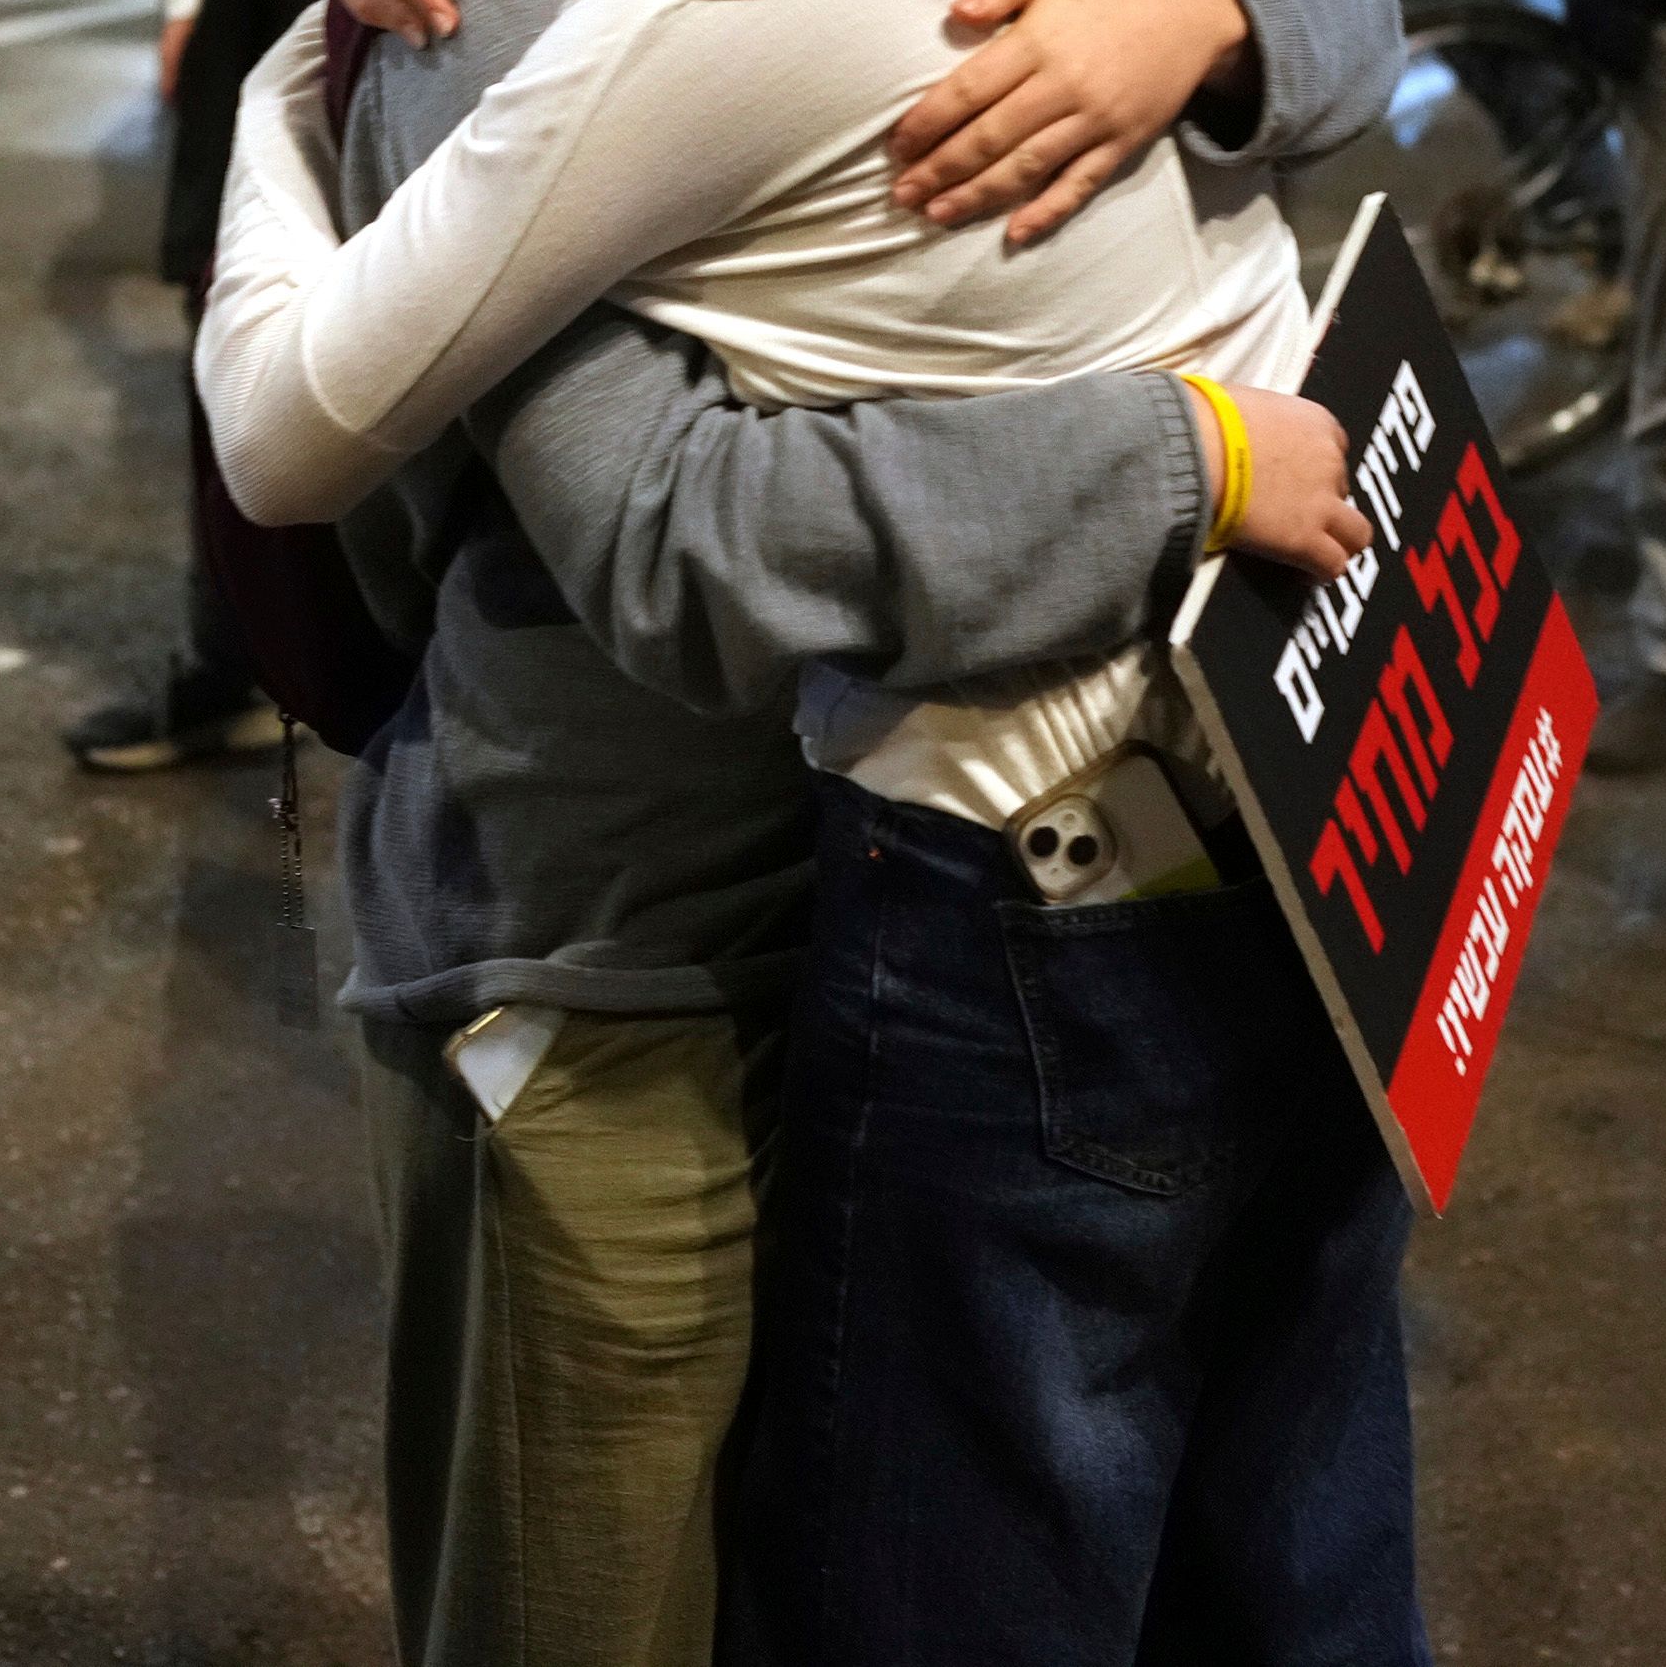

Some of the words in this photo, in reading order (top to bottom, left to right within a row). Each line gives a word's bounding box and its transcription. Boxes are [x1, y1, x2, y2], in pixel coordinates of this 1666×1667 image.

[1356, 358, 1436, 553] פדיון
[1404, 440, 1522, 691] בכל
[1309, 623, 1454, 956] מחיר
[1491, 705, 1563, 909] #עסקה
[1436, 875, 1509, 1077] עכשיו!
